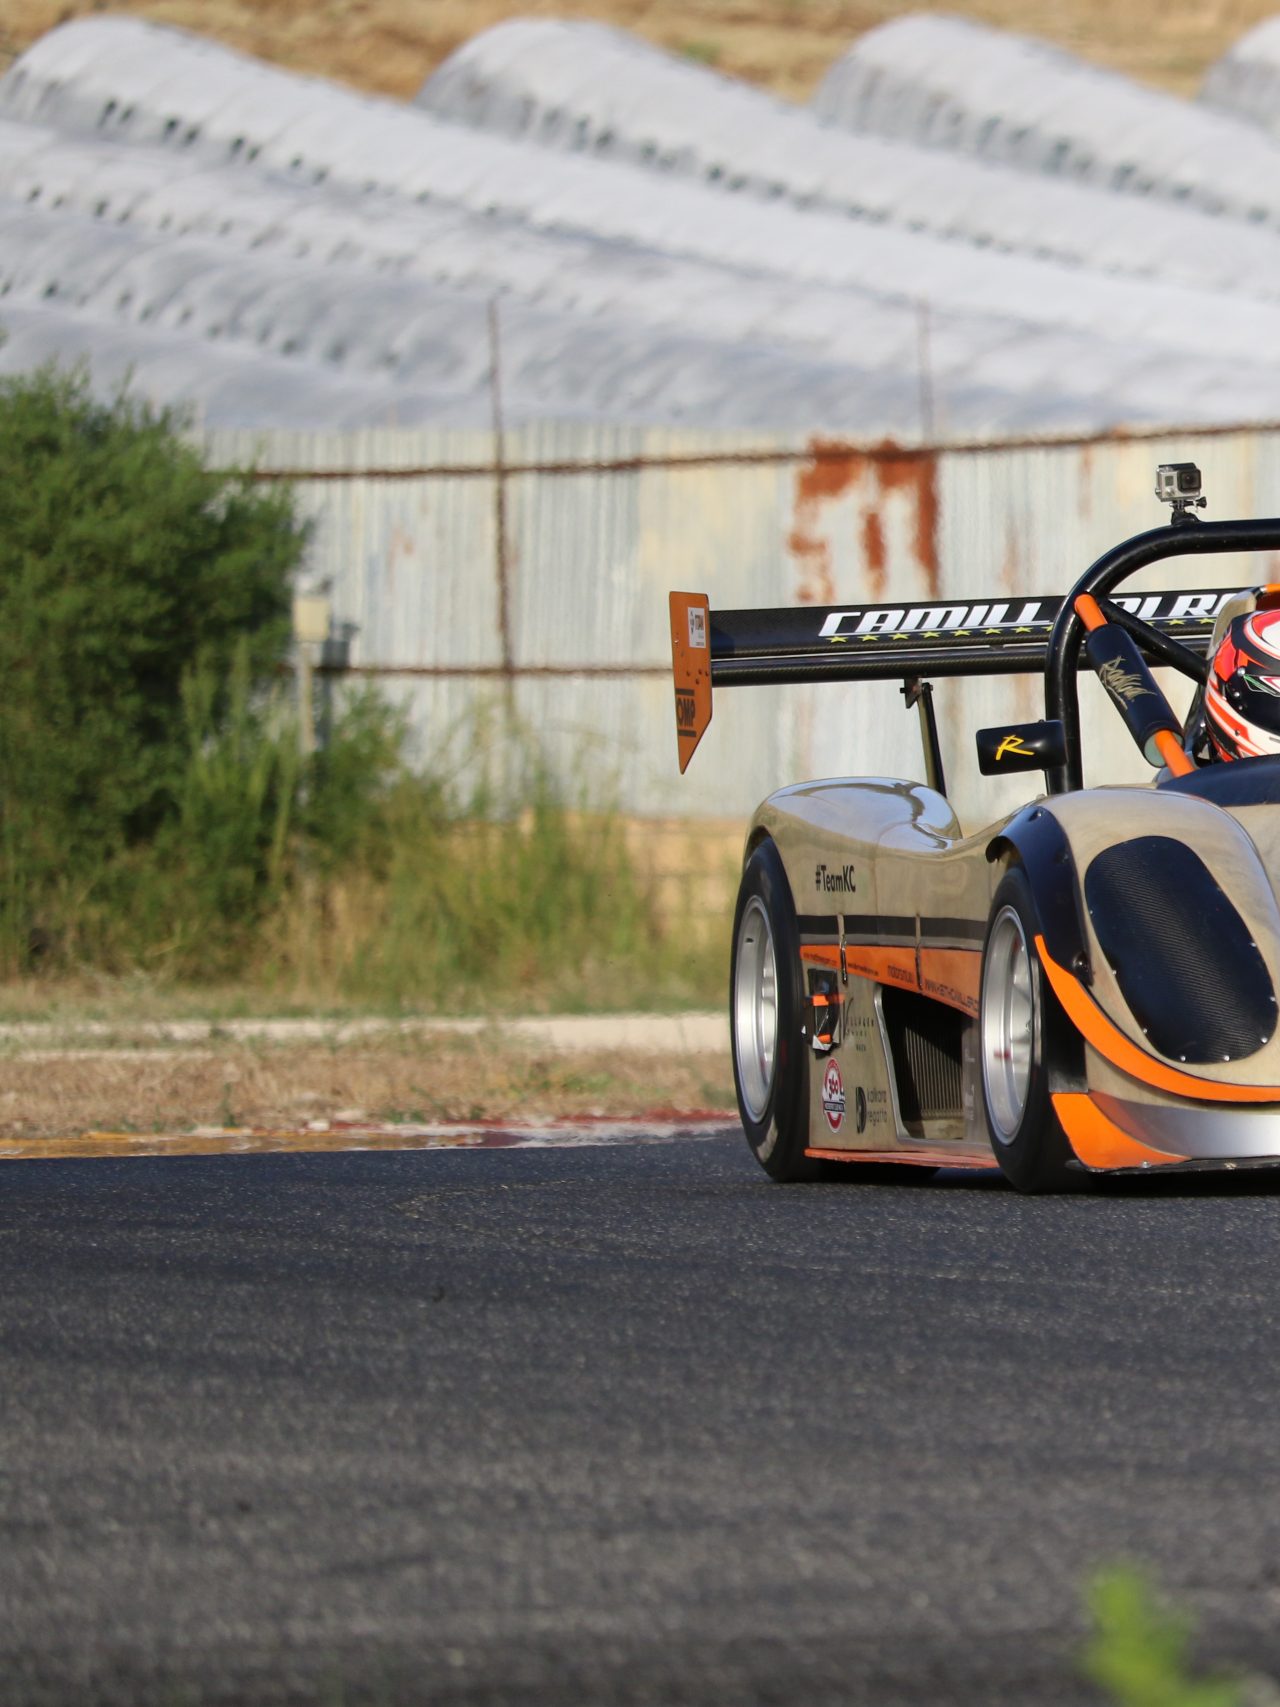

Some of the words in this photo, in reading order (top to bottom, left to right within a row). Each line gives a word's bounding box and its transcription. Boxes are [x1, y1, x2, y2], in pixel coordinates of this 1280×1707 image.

[676, 697, 696, 728] OMP
[995, 734, 1035, 761] R
[815, 864, 856, 893] #TeamKC
